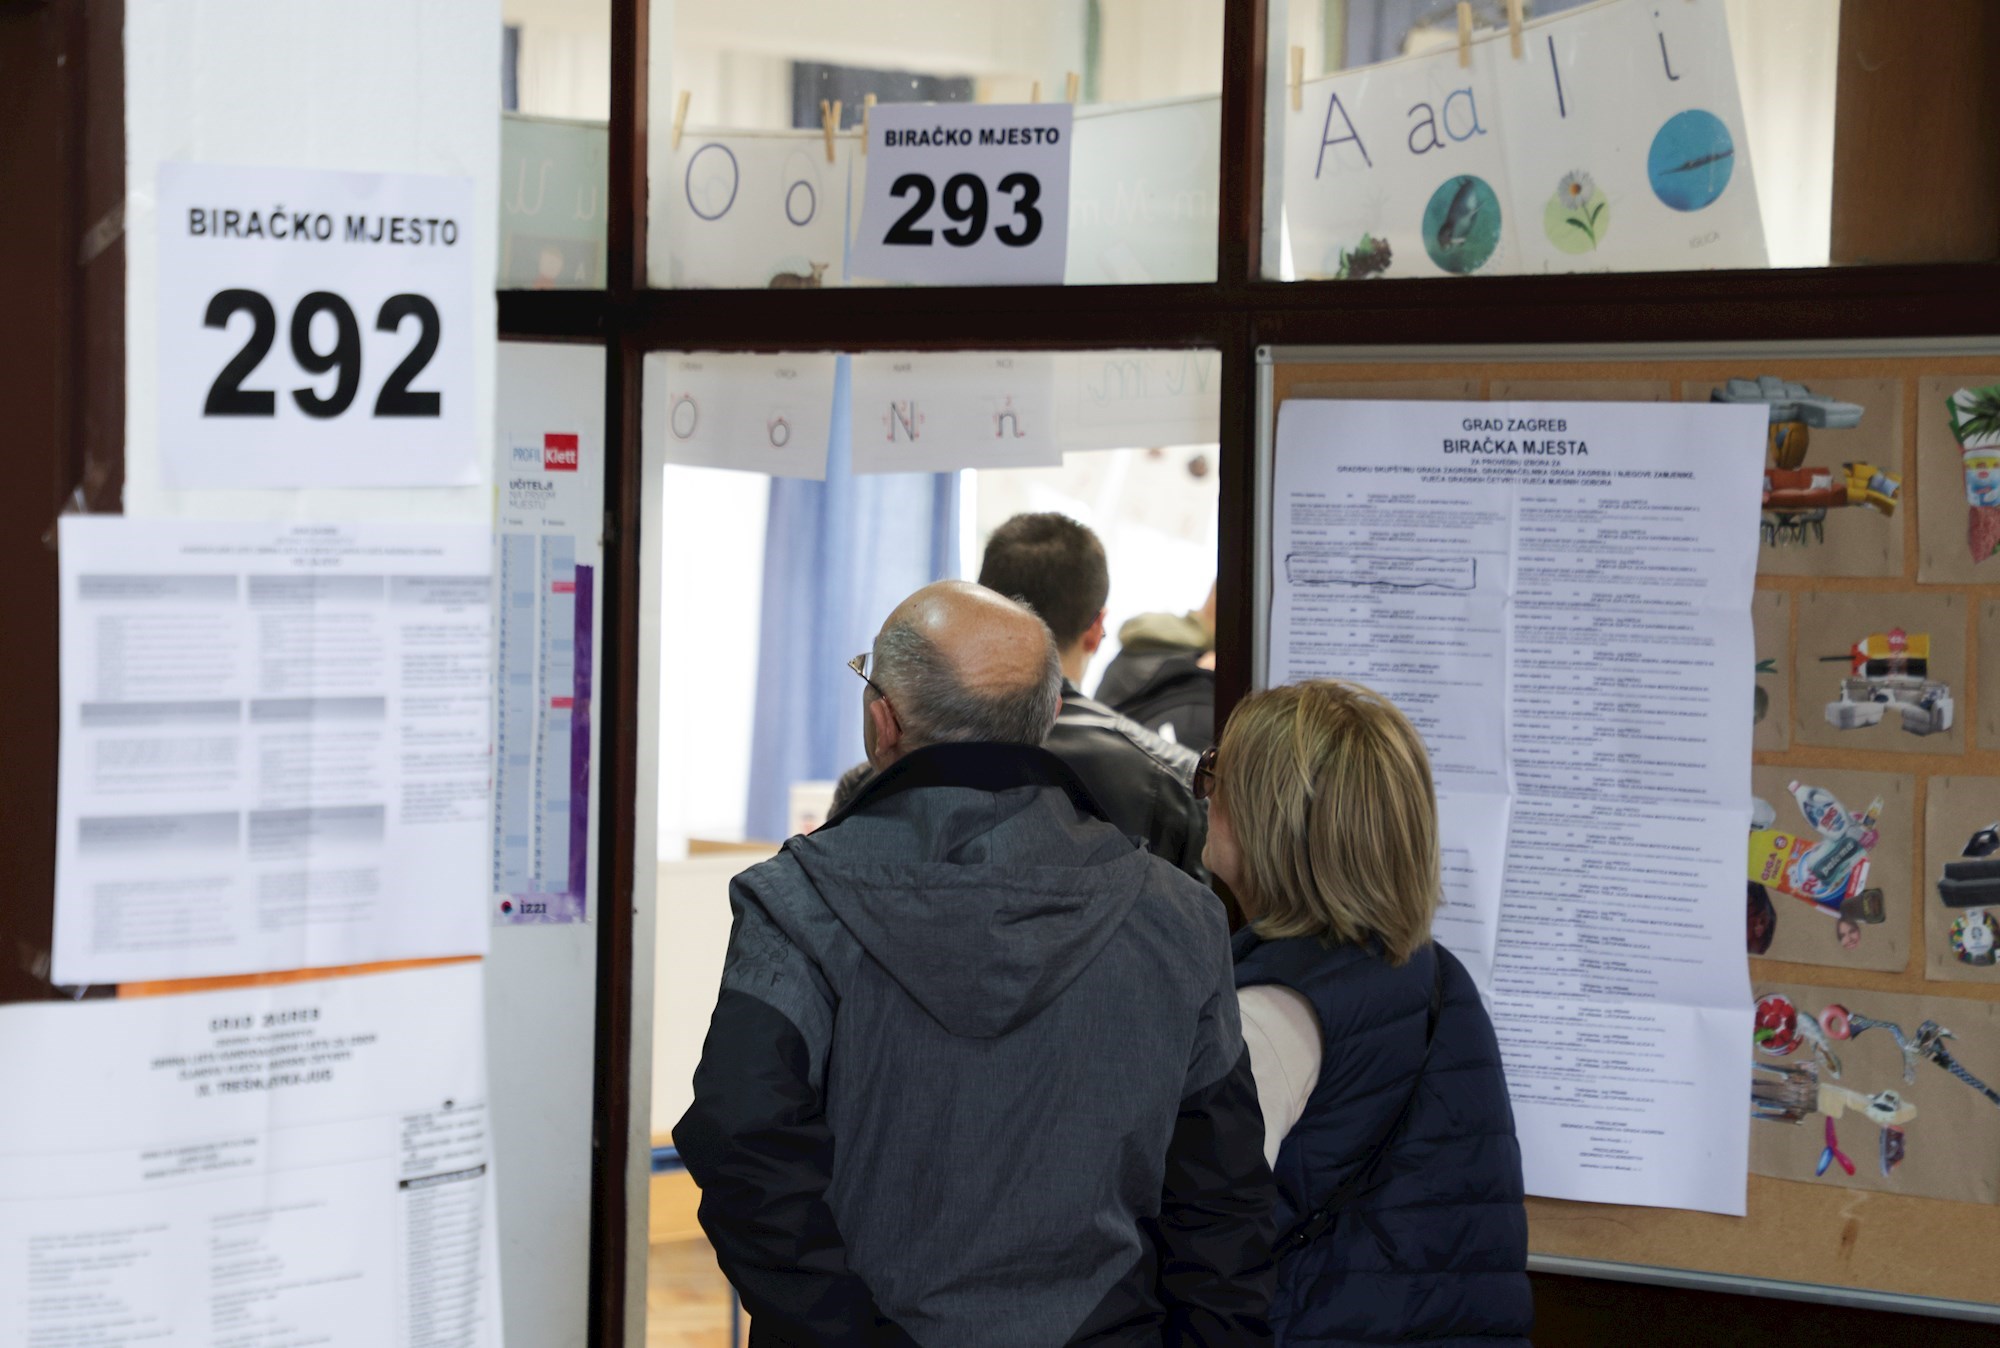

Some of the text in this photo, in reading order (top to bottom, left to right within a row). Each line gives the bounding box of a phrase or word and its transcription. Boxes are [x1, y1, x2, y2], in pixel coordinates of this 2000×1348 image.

[1654, 11, 1680, 81] i
[885, 125, 1060, 147] BIRAČKO MJESTO
[1315, 92, 1373, 180] A
[188, 204, 458, 246] BIRAČKO MJESTO
[882, 171, 1044, 248] 293
[202, 287, 442, 420] 292
[1462, 418, 1567, 432] GRAD ZAGREB
[545, 448, 577, 464] Klett
[1443, 437, 1589, 456] BIRAČKA MJESTA
